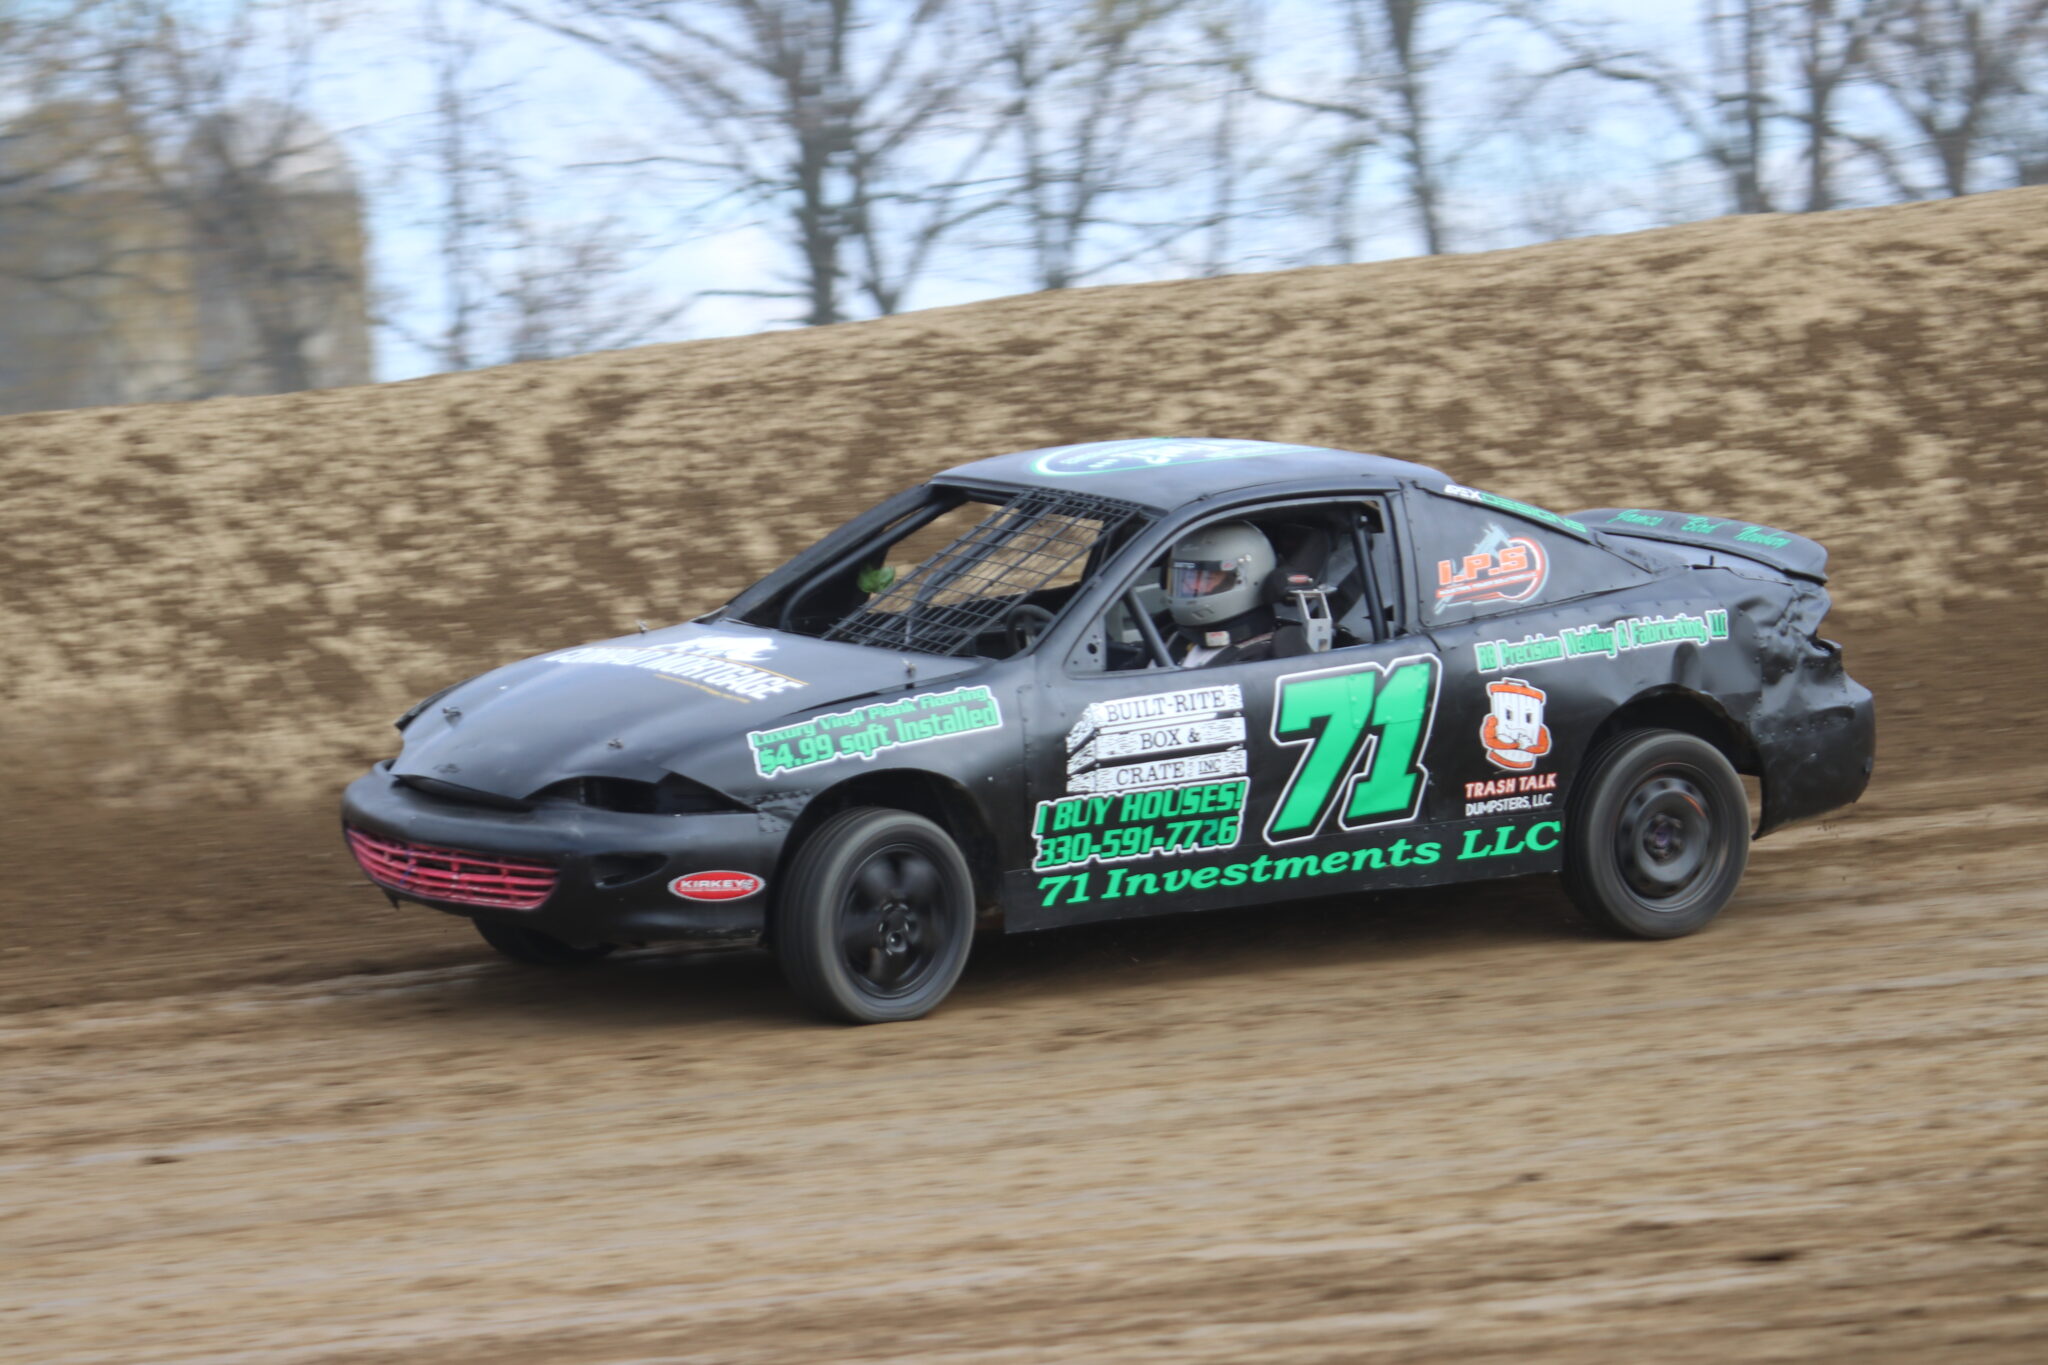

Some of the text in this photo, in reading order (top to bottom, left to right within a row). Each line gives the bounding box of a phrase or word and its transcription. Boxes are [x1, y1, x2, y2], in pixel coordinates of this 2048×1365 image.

[1499, 636, 1564, 668] Precision
[1561, 626, 1616, 657] Welding
[637, 650, 804, 700] MORTGAGE
[751, 687, 989, 747] Luxury Vinyl Plank Flooring
[1107, 689, 1226, 723] BUILT-RITE
[759, 700, 999, 775] $4.99 sqft Installed
[1140, 727, 1201, 751] BOX &
[1268, 658, 1437, 840] 71
[1116, 758, 1222, 786] CRATE INC
[1464, 773, 1558, 798] TRASH TALK
[1036, 781, 1247, 835] I BUY HOUSES!
[1465, 793, 1553, 817] DUMPSTERS, LLC
[1036, 815, 1240, 868] 330-591-7726
[1037, 819, 1562, 907] 71 Investments LLC
[681, 879, 746, 889] KIRKEY
